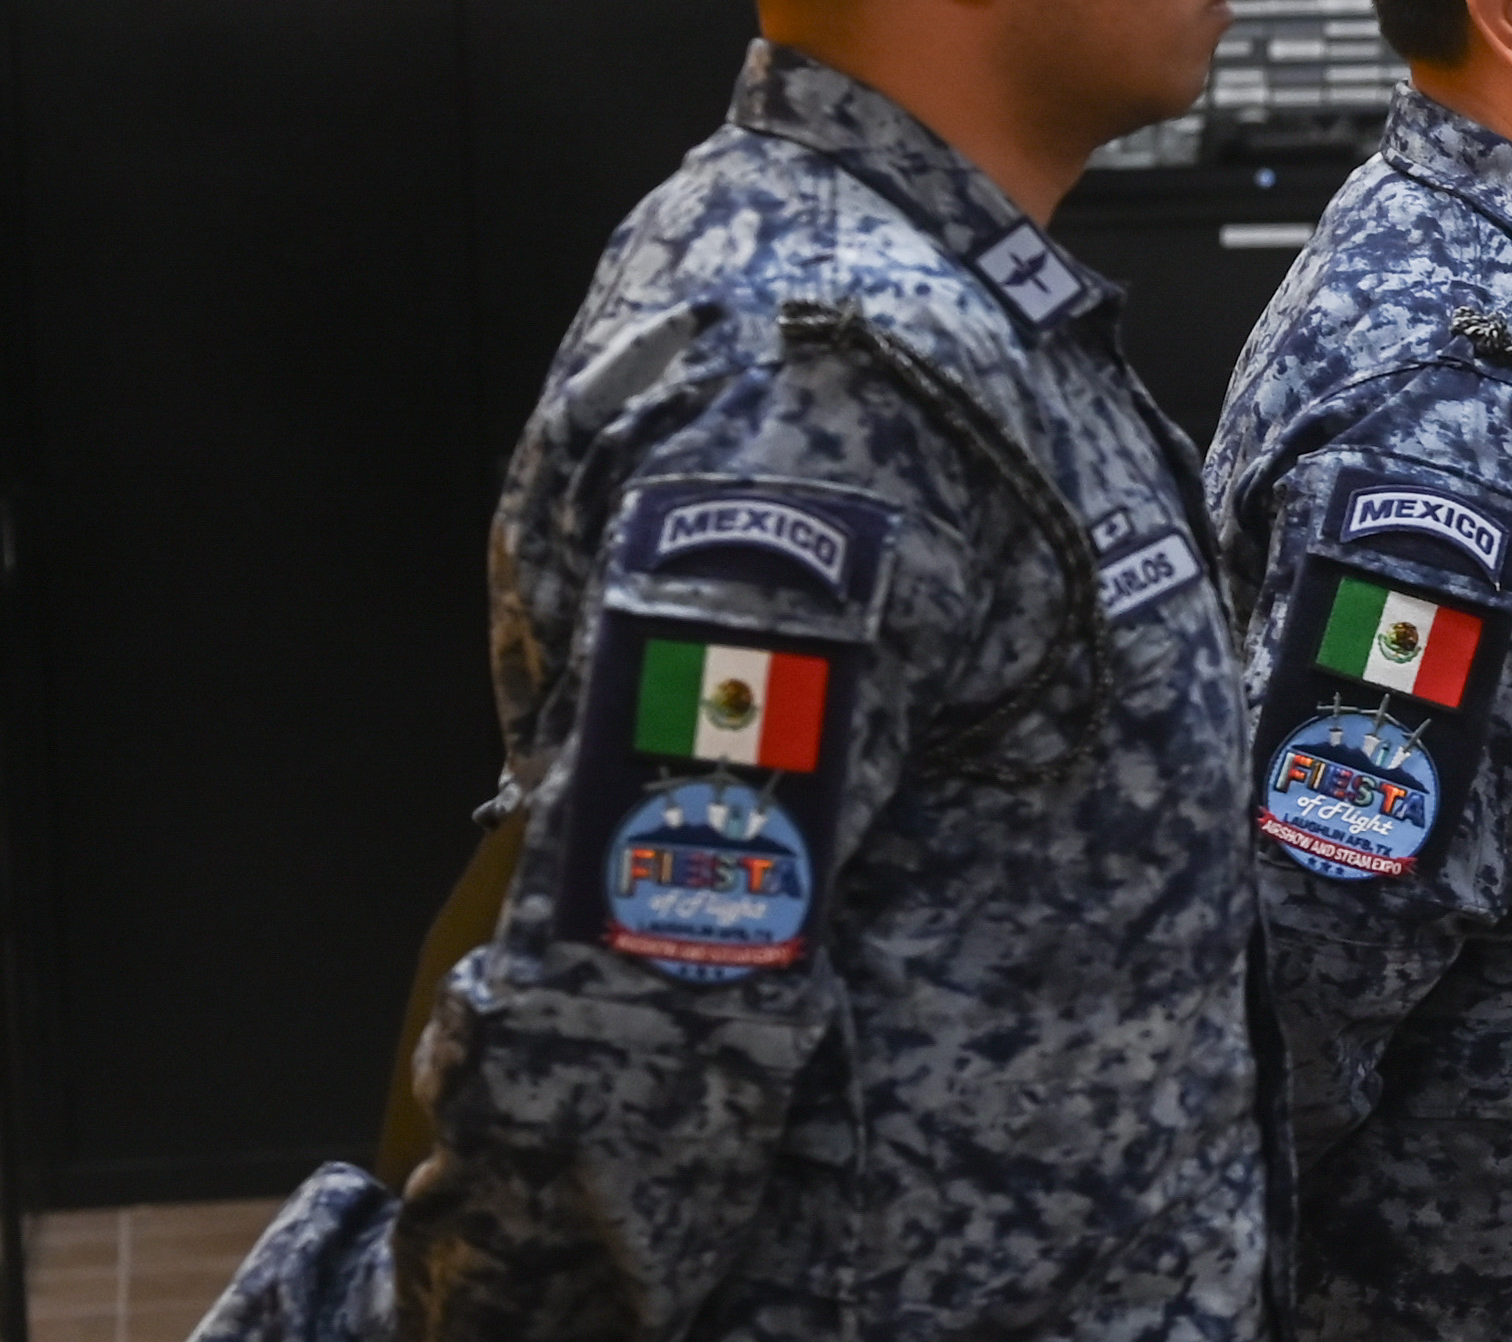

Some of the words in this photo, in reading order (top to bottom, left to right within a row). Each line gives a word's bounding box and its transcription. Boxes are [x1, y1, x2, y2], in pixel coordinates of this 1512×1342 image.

[669, 509, 838, 566] MEXICO
[1359, 499, 1495, 556] MEXICO
[1273, 751, 1426, 829] FIESTA
[1297, 794, 1327, 817] of
[1318, 802, 1394, 835] Flight
[619, 846, 802, 900] FIESTA
[1310, 839, 1336, 858] AND
[1371, 857, 1402, 875] EXPO
[1375, 844, 1393, 858] TX
